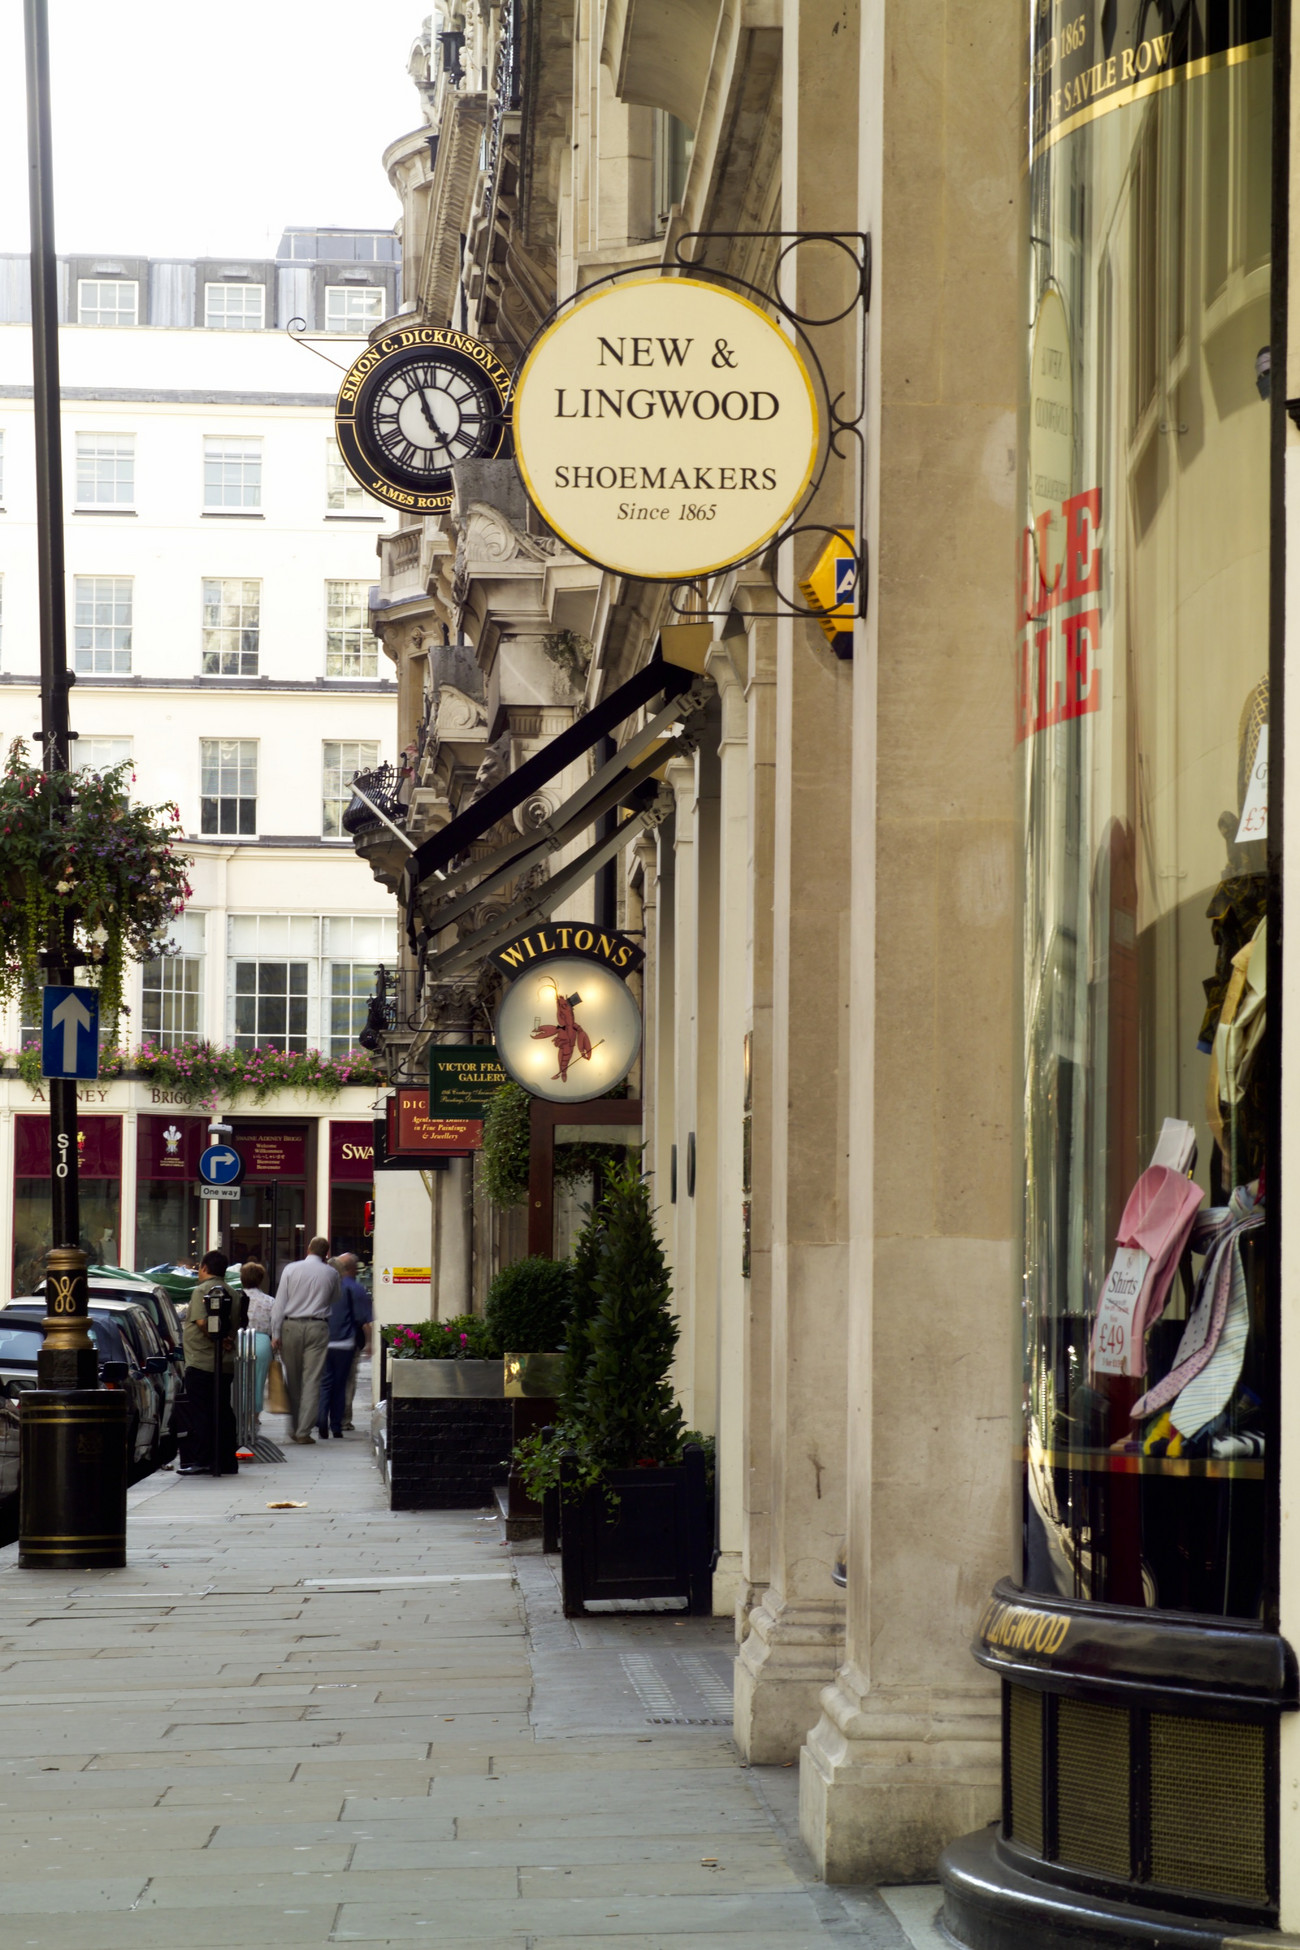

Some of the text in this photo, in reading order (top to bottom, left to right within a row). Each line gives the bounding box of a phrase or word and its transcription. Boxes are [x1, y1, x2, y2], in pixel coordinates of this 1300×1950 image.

[1060, 14, 1086, 59] 1865
[1064, 58, 1117, 112] SAVILE
[1121, 32, 1174, 80] ROW
[342, 348, 382, 402] SIMON
[381, 339, 399, 354] C.
[400, 329, 498, 370] DICKINSON
[596, 336, 739, 369] NEW &
[554, 388, 780, 422] LINGWOOD
[554, 466, 778, 491] SHOEMAKERS
[372, 479, 415, 506] JAMES
[616, 502, 718, 522] Since 1865
[499, 928, 634, 968] WILTONS
[438, 1062, 506, 1072] VICTOR FRA
[458, 1073, 507, 1082] GALLERY
[31, 1087, 108, 1102] ANEY
[402, 1100, 426, 1109] DIC
[430, 1132, 458, 1140] Jewellery
[438, 1124, 467, 1132] Paintings
[1108, 1270, 1138, 1296] Shirts
[1098, 1322, 1124, 1356] £49
